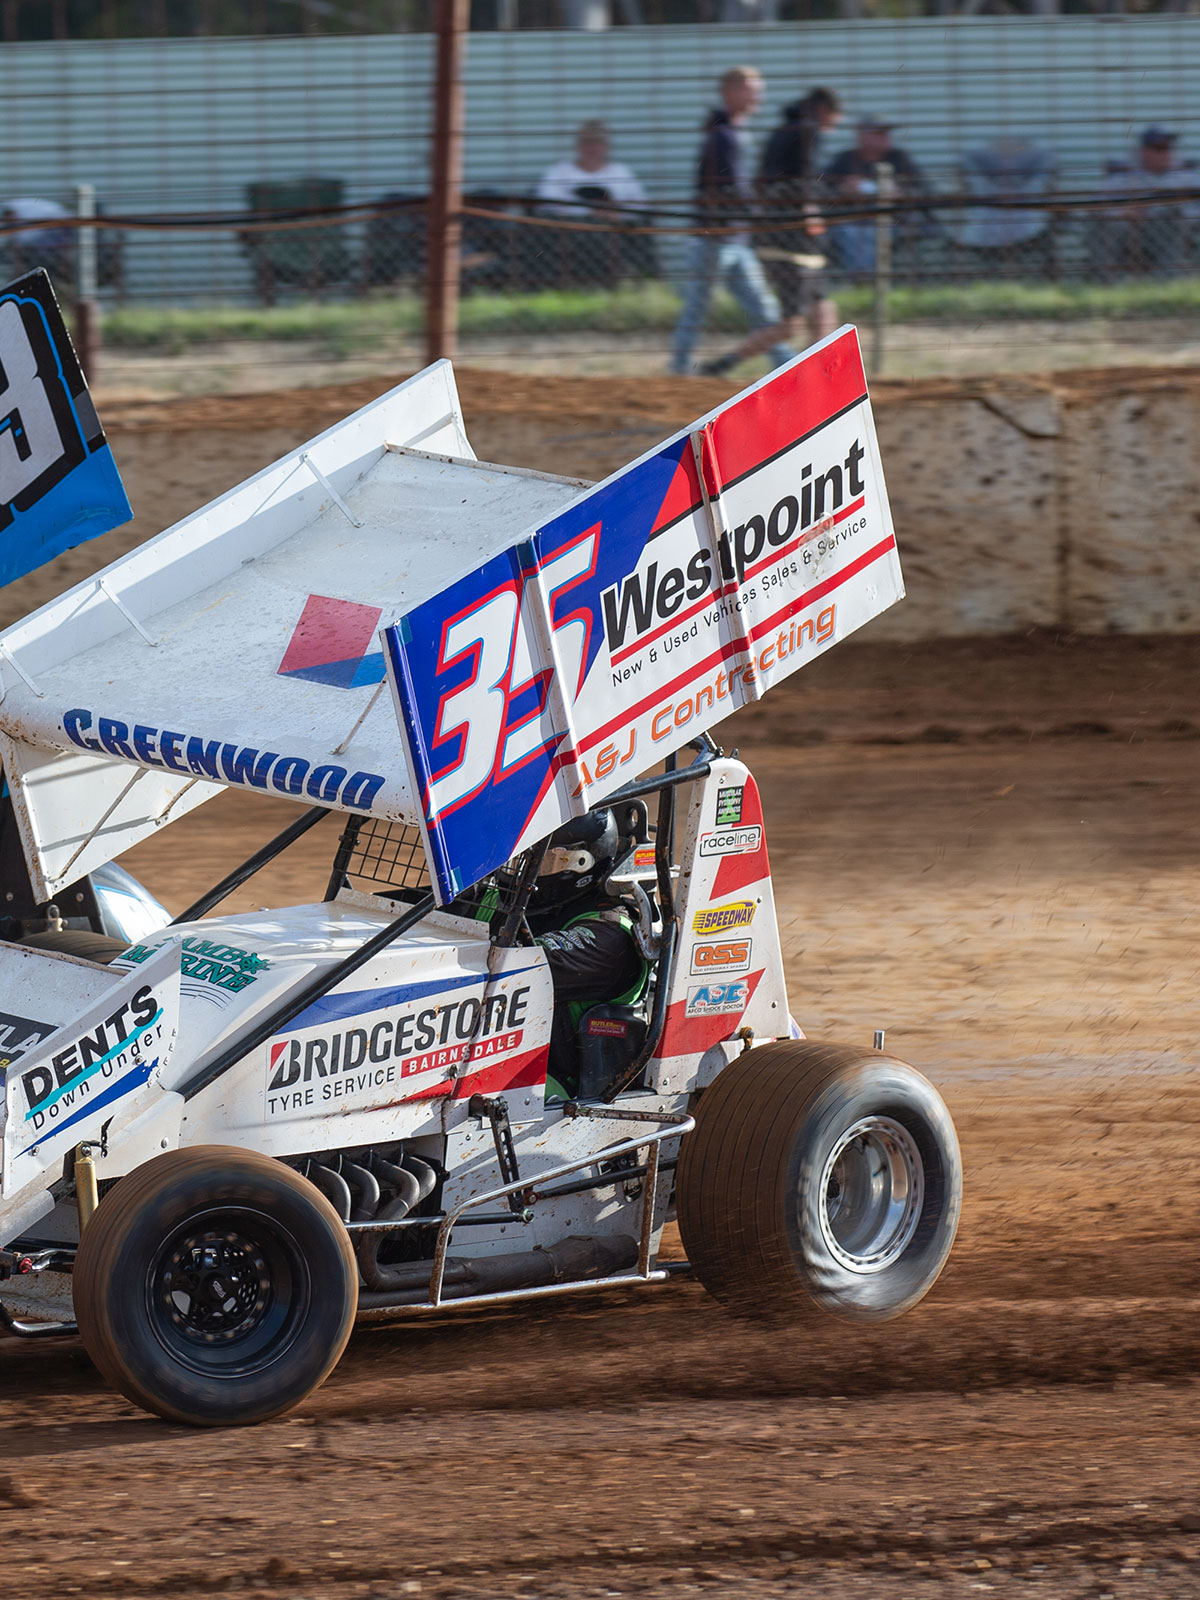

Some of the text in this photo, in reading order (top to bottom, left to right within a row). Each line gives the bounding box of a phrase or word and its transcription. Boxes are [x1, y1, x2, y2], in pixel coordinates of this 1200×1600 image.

[603, 438, 865, 653] Westpoint
[612, 516, 867, 687] New & Used Vehices Sales & Service
[424, 522, 602, 829] 35
[571, 603, 836, 797] A&J Contracting
[63, 708, 386, 810] GREENWOOD
[703, 832, 756, 849] raceline
[694, 942, 749, 967] QSS
[704, 907, 754, 928] SPEEDWAY
[119, 945, 258, 993] MRINE
[689, 984, 746, 1008] ASD
[21, 985, 158, 1110] DENTS
[33, 1081, 90, 1130] Down
[101, 1024, 162, 1078] Under
[267, 985, 530, 1091] BRIDGESTONE
[409, 1035, 516, 1073] BAIRNSDALE
[268, 1066, 396, 1115] TYRE SERVICE
